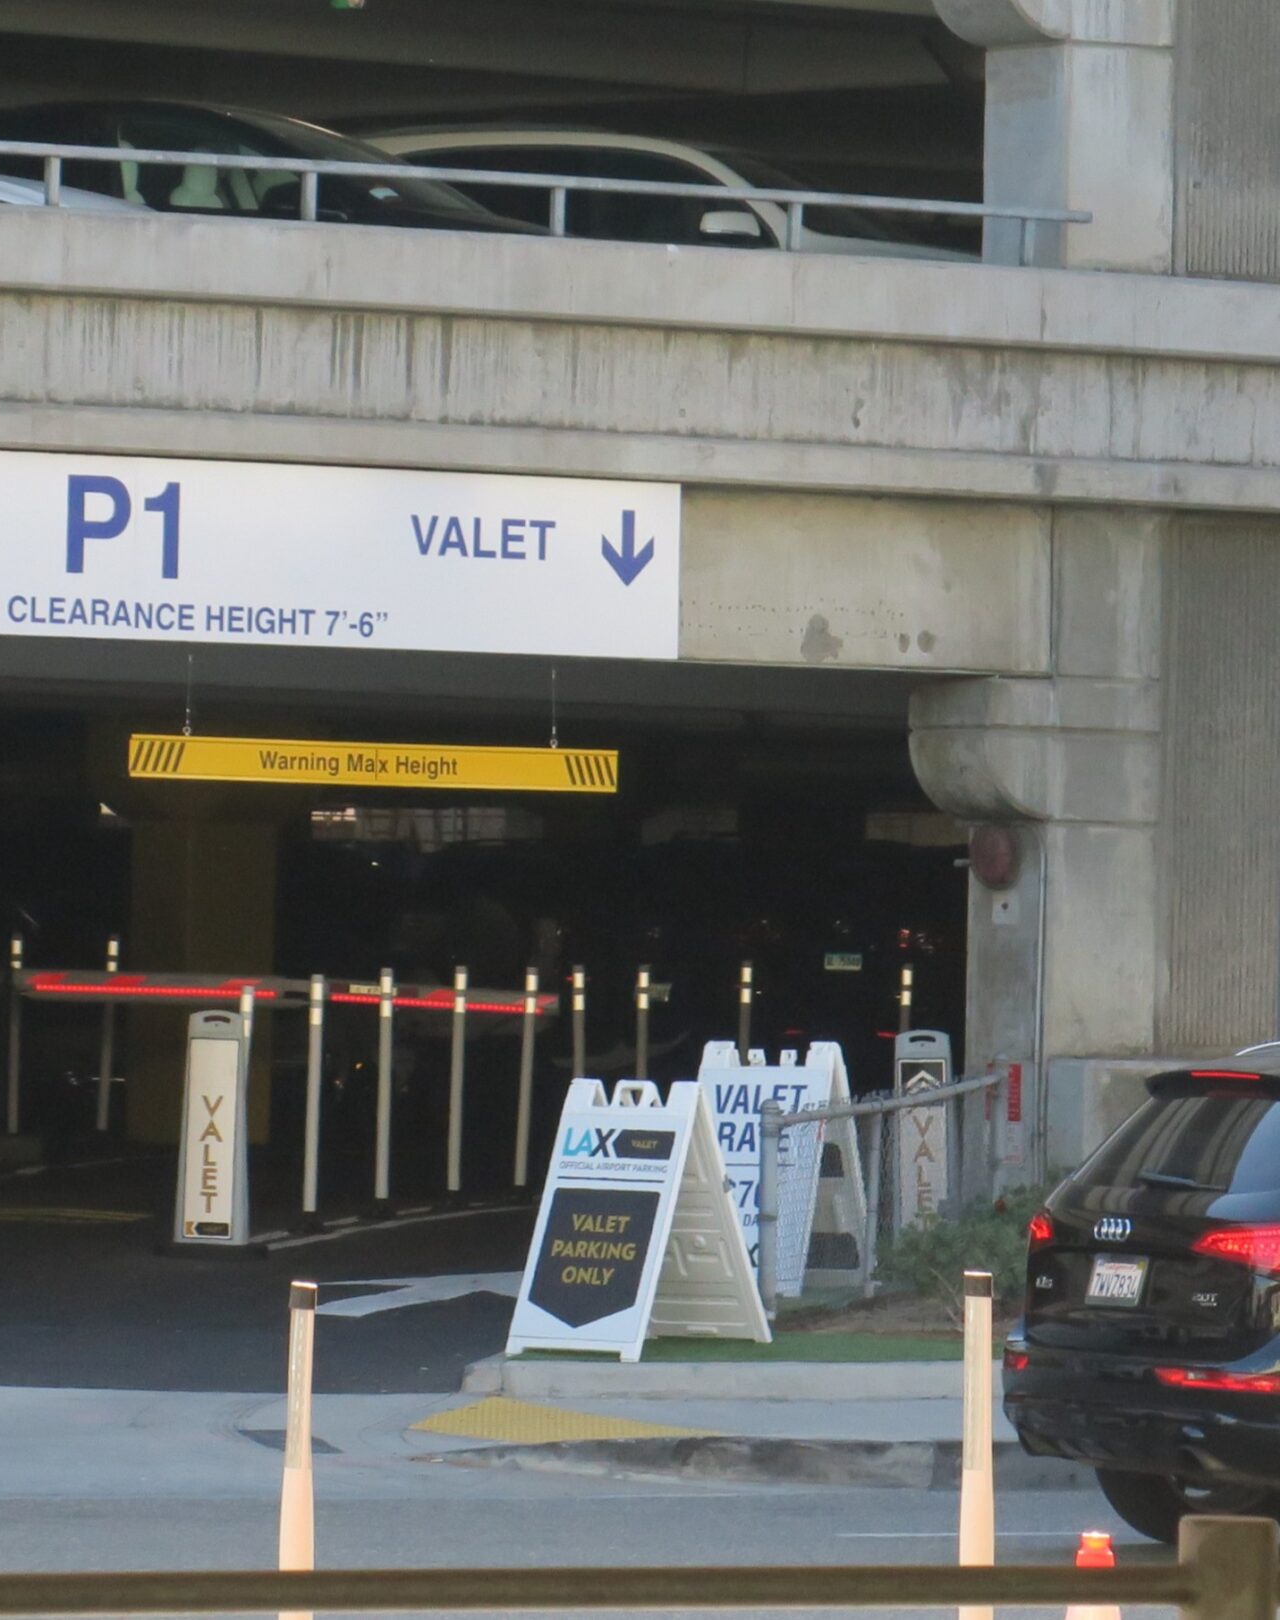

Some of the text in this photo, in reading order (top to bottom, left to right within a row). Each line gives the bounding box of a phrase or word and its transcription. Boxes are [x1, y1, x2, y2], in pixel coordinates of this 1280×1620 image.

[65, 474, 181, 579] P1
[411, 514, 556, 561] VALET
[7, 595, 195, 631] CLEARANCE
[206, 605, 316, 636] HEIGHT
[259, 750, 458, 780] Warning Max Height
[200, 1095, 223, 1214] VALET
[562, 1127, 616, 1158] LAX
[559, 1160, 668, 1174] OFFICIAL AIRPORT PARKING
[572, 1213, 631, 1233] VALET
[551, 1239, 637, 1260] PARKING
[561, 1265, 615, 1286] ONLY
